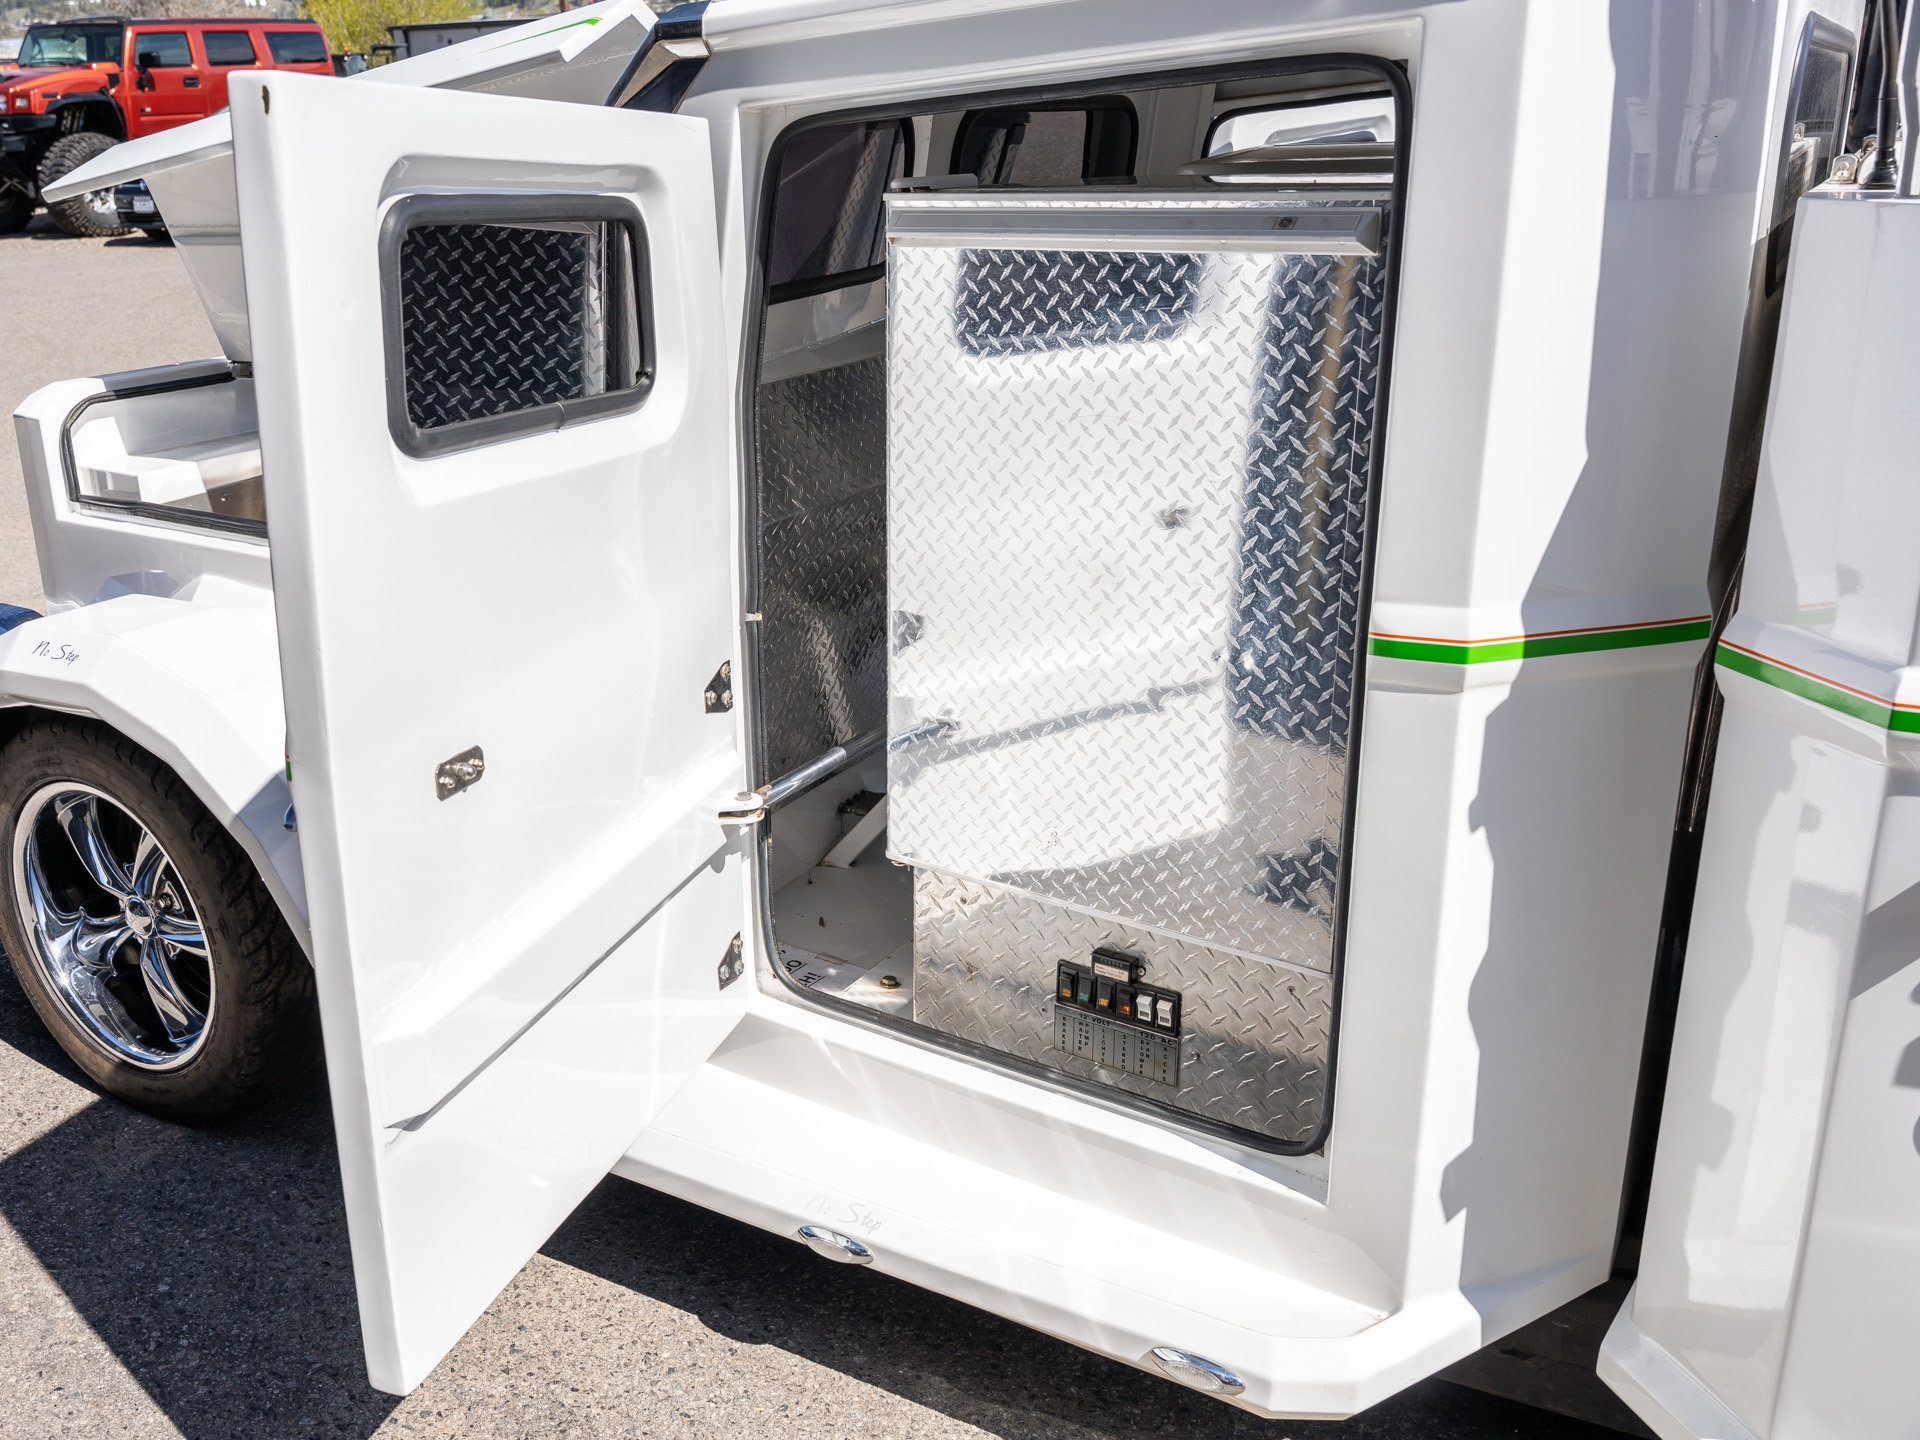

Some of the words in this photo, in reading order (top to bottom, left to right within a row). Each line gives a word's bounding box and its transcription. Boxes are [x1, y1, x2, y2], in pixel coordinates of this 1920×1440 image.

[50, 644, 80, 667] Step
[1091, 1016, 1111, 1027] VOLT
[1139, 1031, 1156, 1041] 120
[1161, 1038, 1173, 1046] AC
[836, 1202, 883, 1237] Step
